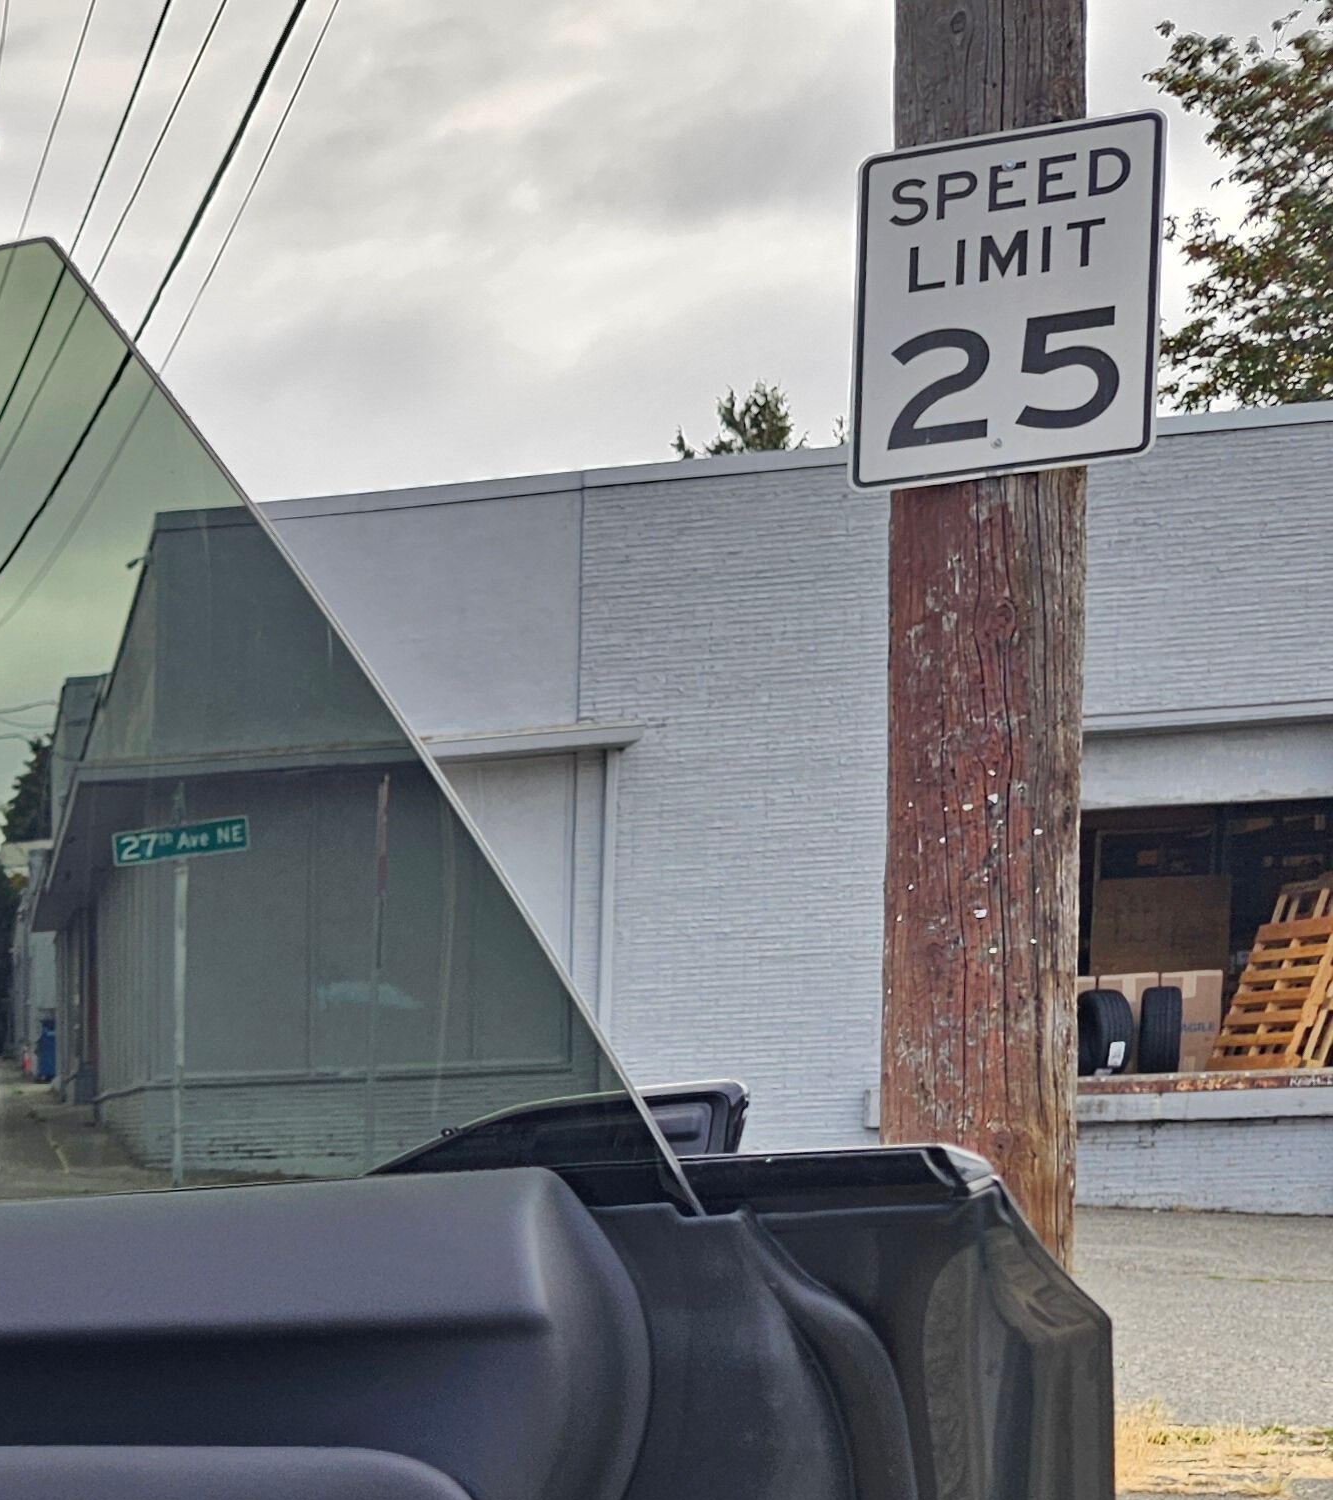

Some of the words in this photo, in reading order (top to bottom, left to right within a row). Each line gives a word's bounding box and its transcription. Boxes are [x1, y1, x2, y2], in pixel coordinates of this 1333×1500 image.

[889, 147, 1132, 226] SPEED
[907, 217, 1106, 293] LIMIT
[887, 305, 1120, 450] 25
[120, 833, 174, 861] 27th
[176, 831, 210, 850] Ave
[216, 824, 244, 845] NE
